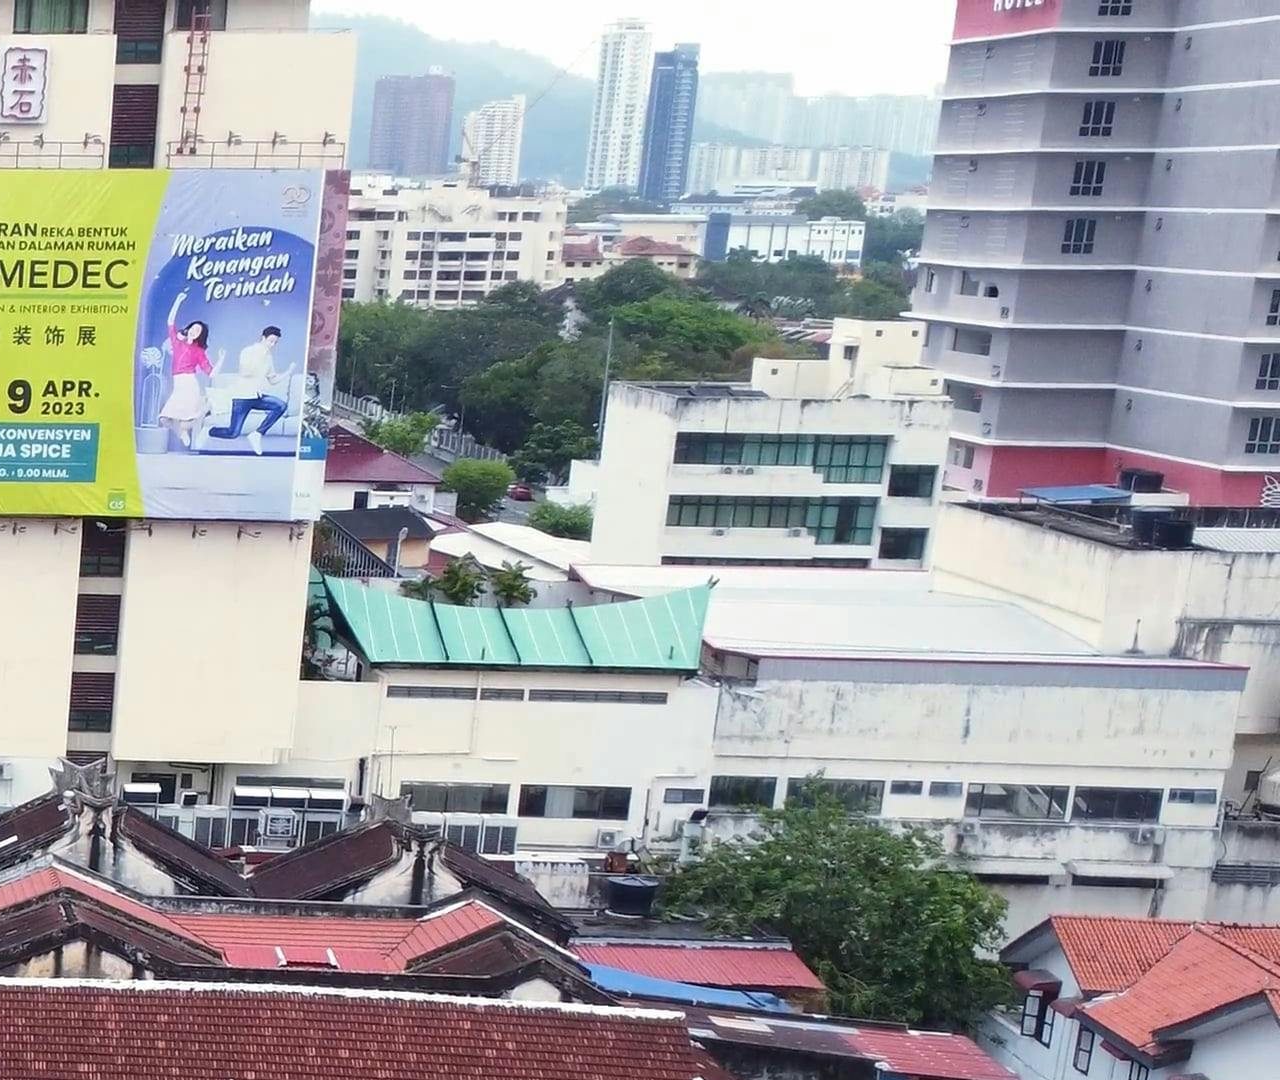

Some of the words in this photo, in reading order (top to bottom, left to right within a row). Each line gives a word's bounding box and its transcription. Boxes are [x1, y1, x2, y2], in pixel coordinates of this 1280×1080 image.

[40, 227, 73, 237] REKA
[78, 227, 128, 238] BENTUK
[18, 240, 84, 250] DALAMAN
[87, 240, 136, 251] RUMAH
[172, 227, 273, 257] Meraikan
[187, 253, 289, 280] Kenangan
[204, 272, 295, 302] Terindah
[9, 304, 16, 313] &
[19, 304, 66, 314] INTERIOR
[70, 305, 128, 314] EXHIBITION
[7, 379, 32, 414] 9
[41, 380, 100, 398] APR.
[41, 402, 85, 415] 2023
[20, 444, 71, 458] SPICE
